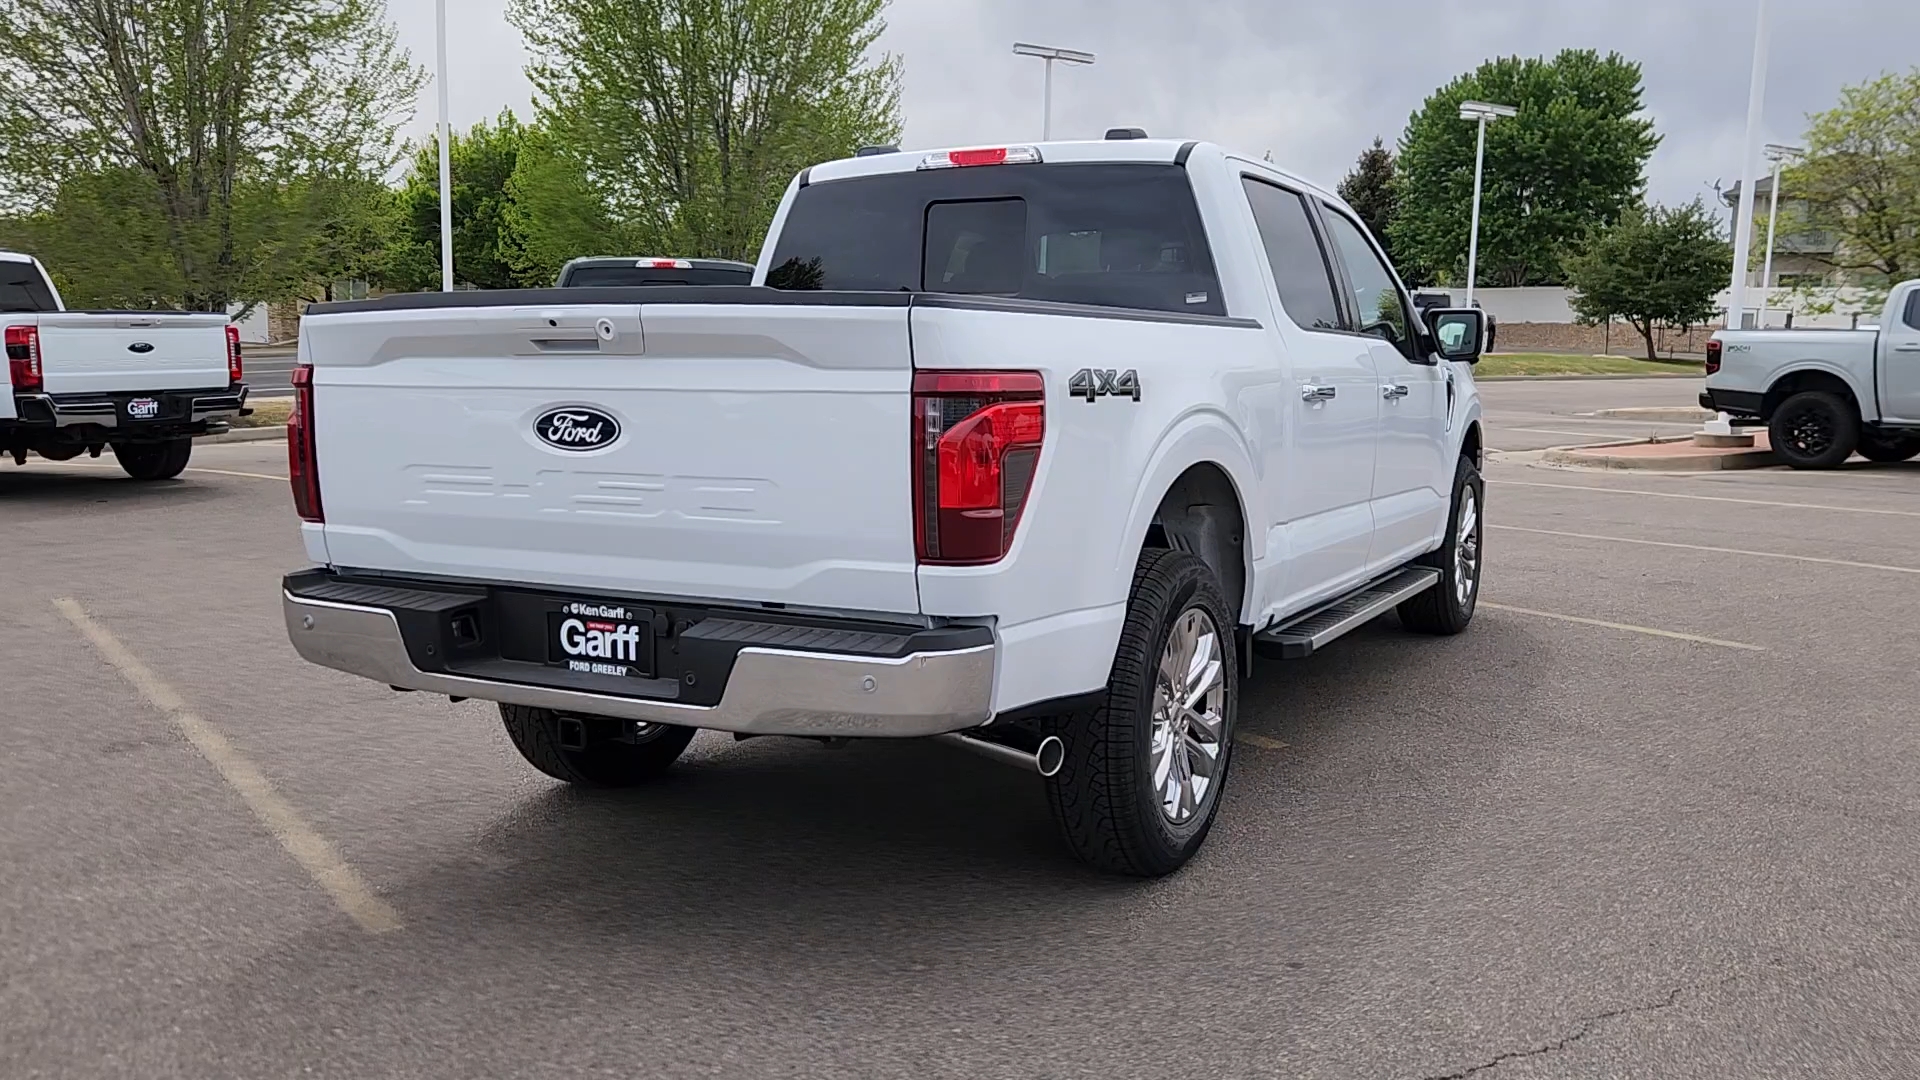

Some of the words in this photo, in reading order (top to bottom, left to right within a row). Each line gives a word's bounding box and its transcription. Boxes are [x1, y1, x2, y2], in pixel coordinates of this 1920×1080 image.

[127, 401, 158, 415] Garff
[548, 413, 603, 443] Ford
[580, 603, 599, 616] Ken
[600, 606, 624, 619] Garff
[560, 618, 639, 661] Garff
[569, 660, 590, 672] FORD
[592, 663, 627, 676] GREELEY
